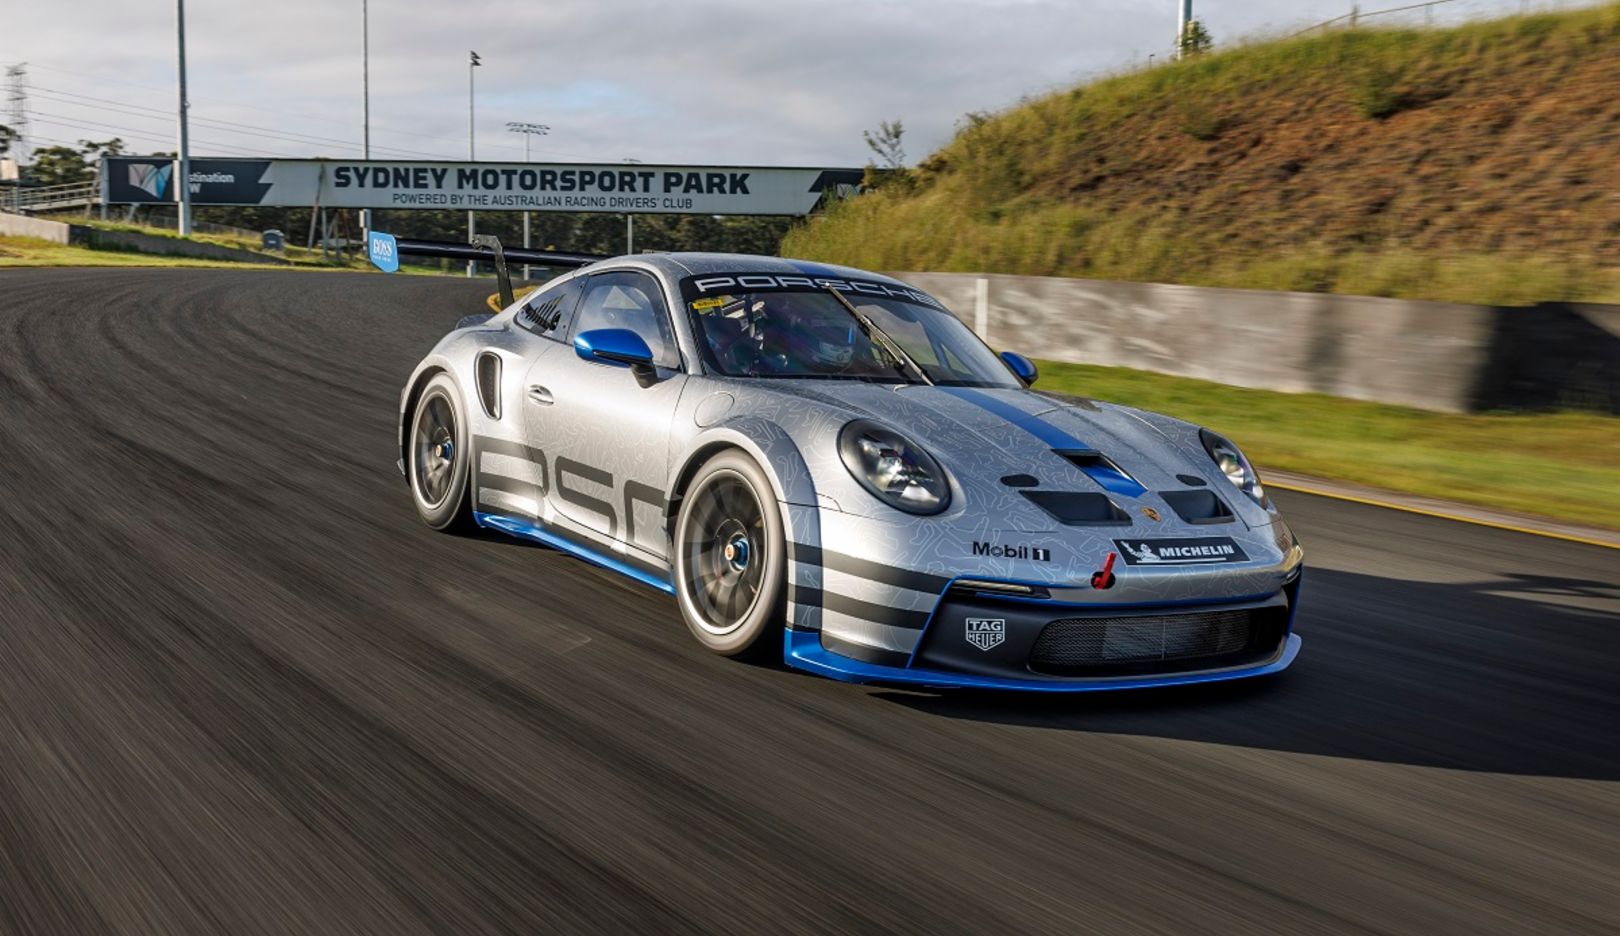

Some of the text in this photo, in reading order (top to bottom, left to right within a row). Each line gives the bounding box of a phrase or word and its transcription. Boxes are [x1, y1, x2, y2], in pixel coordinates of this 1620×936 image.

[334, 167, 750, 194] SYDNEY MOTORSPORT PARK
[392, 193, 693, 209] POWERED BY THE AUSTRALIAN RACING DRIVERS' CLUB
[693, 275, 945, 310] PORSCHE
[972, 541, 1028, 559] Mobil
[1158, 544, 1235, 558] MICHELIN
[968, 620, 1001, 631] TAG
[968, 632, 1003, 648] HEUER
